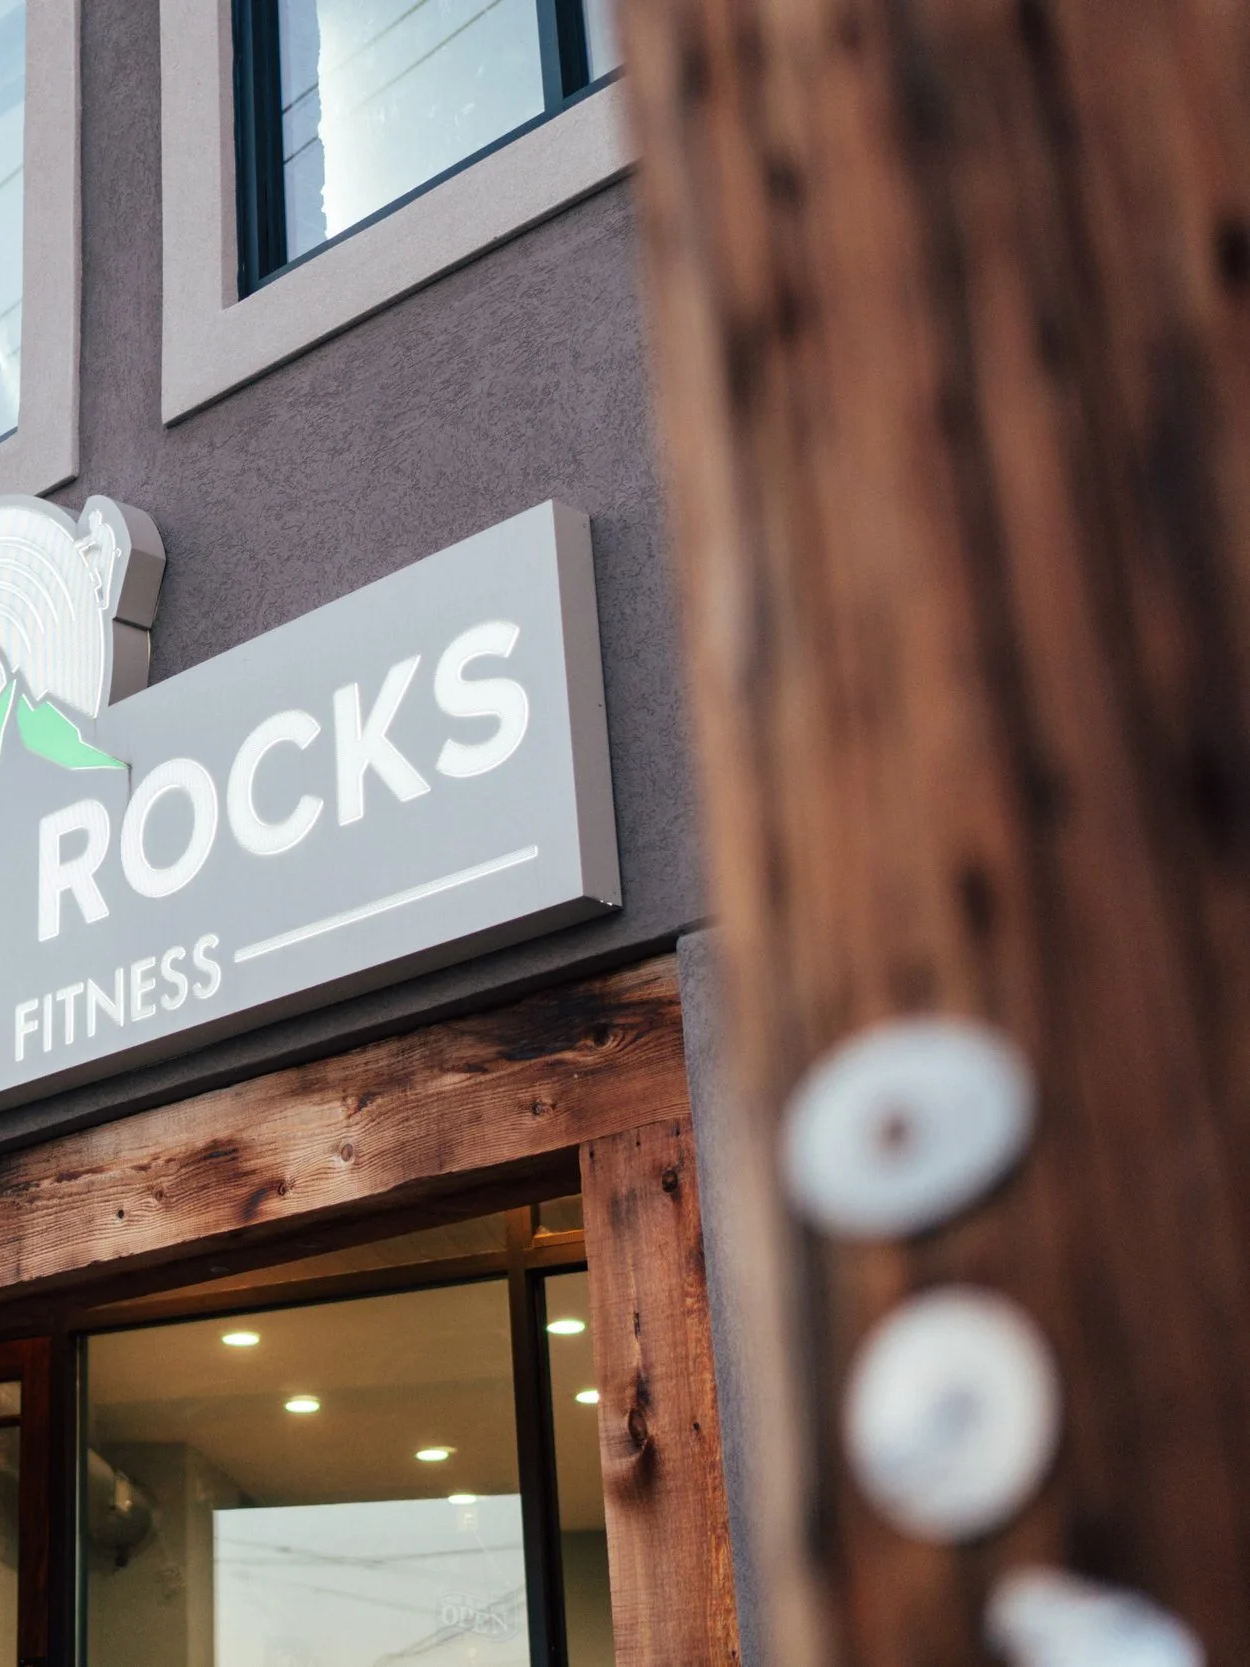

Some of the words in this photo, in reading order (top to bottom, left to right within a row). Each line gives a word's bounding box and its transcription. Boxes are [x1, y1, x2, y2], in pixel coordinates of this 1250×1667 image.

[38, 620, 529, 942] ROCKS
[14, 933, 222, 1063] FITNESS
[441, 1604, 508, 1634] OPEN
